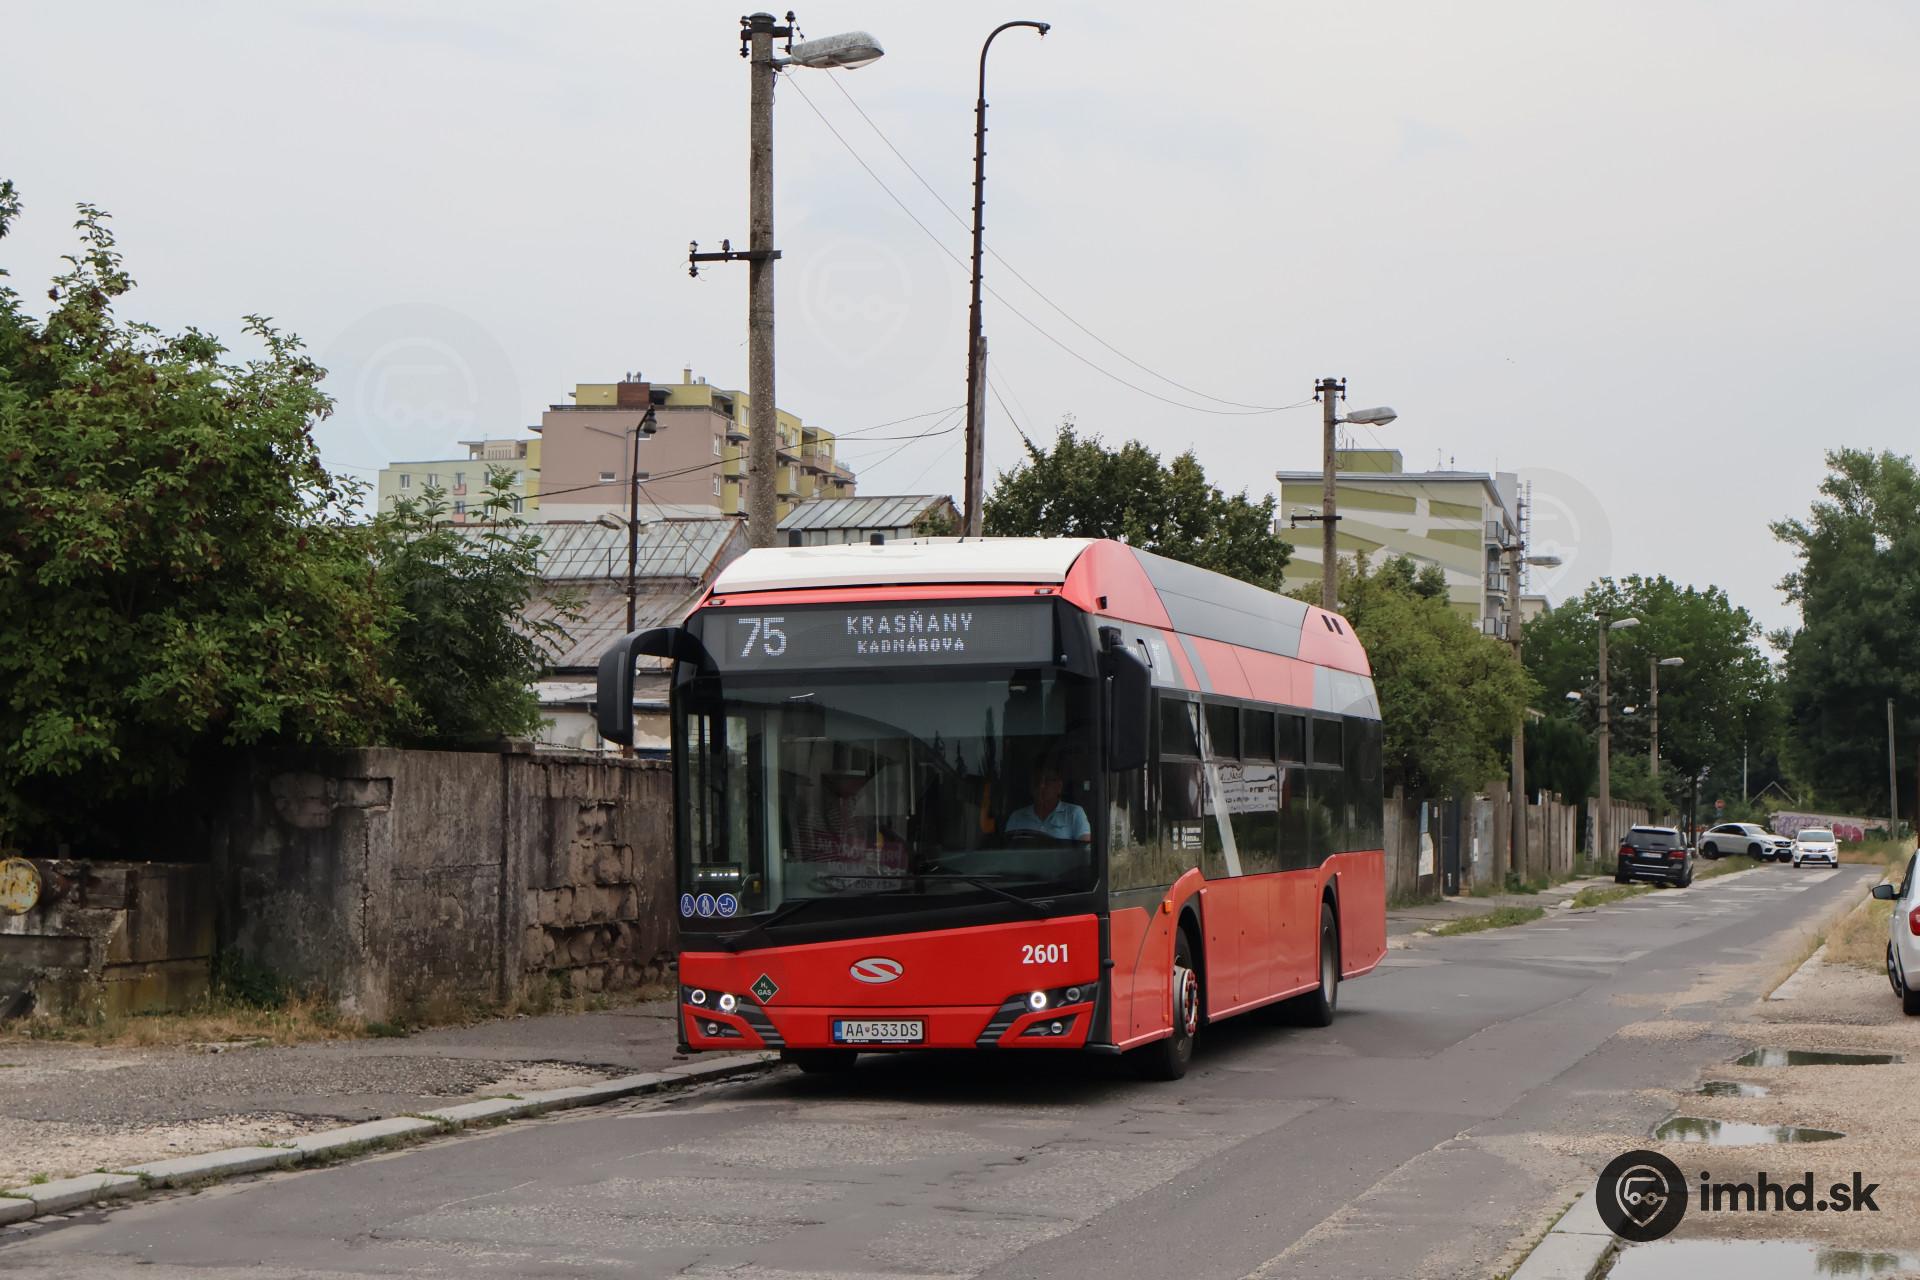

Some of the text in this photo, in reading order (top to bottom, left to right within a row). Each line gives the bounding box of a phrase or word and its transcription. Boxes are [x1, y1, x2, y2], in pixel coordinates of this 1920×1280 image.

[846, 610, 974, 635] KRASŇANY
[738, 616, 788, 656] 75
[856, 636, 965, 655] KADNÁROVA
[1021, 943, 1069, 965] 2601
